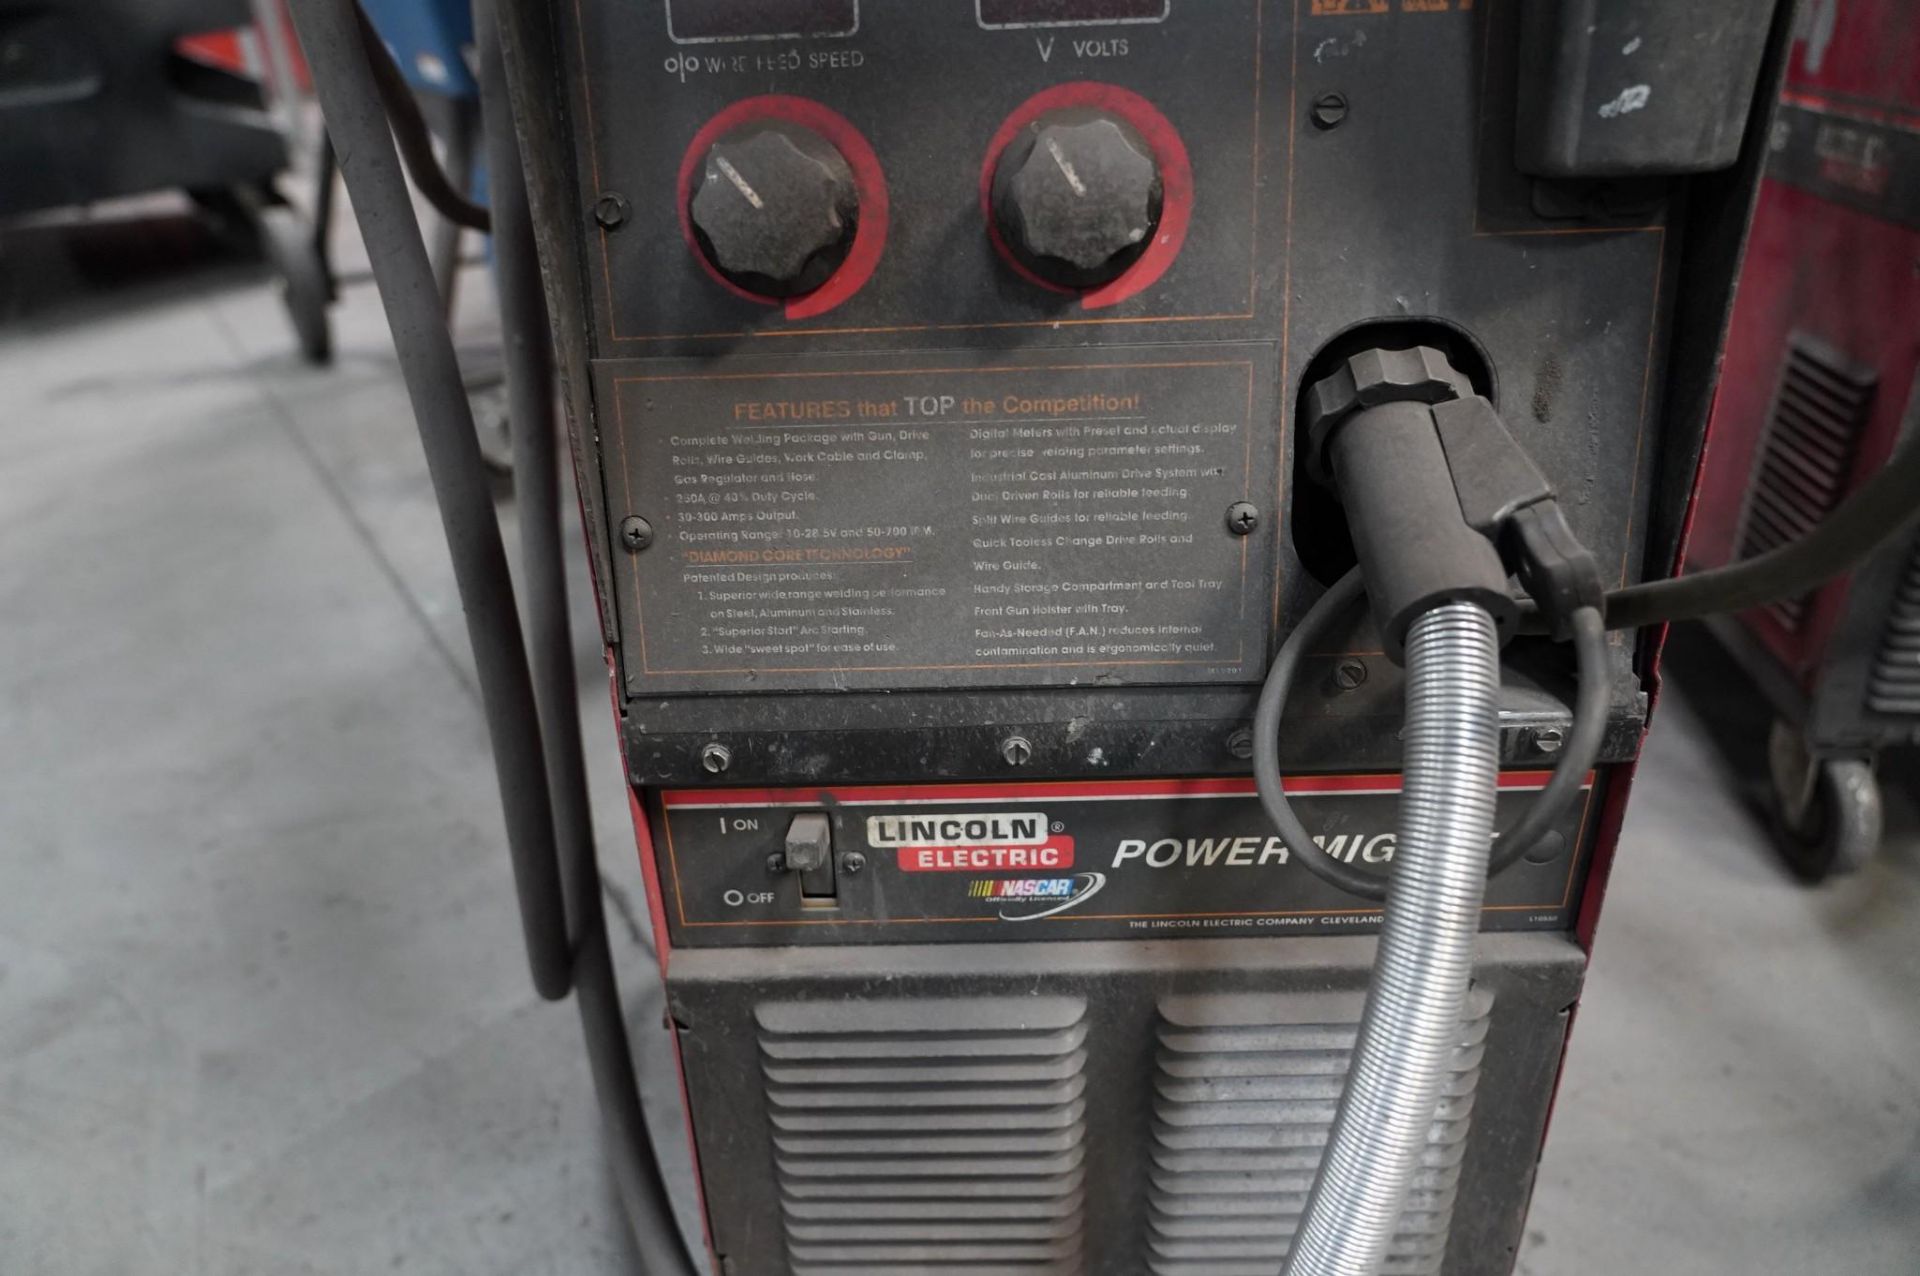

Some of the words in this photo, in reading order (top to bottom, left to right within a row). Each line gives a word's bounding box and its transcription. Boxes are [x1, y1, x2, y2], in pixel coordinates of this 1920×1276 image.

[1072, 38, 1129, 58] VOLTS
[808, 50, 864, 69] SPEED
[734, 400, 850, 420] FEATURES
[857, 400, 898, 417] that
[903, 395, 955, 416] TOP
[961, 398, 995, 414] the
[1003, 394, 1140, 414] Competition!
[670, 435, 729, 447] Complete
[731, 434, 781, 446] Welding
[783, 433, 838, 445] Package
[841, 432, 864, 442] with
[899, 430, 930, 440] Drive
[969, 427, 1009, 440] Digital
[1012, 426, 1053, 438] Meters
[1056, 426, 1081, 437] with
[1083, 424, 1121, 437] Preset
[1123, 424, 1148, 435] and
[706, 454, 733, 464] Wire
[784, 452, 814, 462] Work
[817, 451, 854, 461] Cable
[857, 450, 881, 461] and
[1088, 444, 1151, 457] parameter
[1154, 443, 1205, 456] settings.
[674, 474, 698, 485] Gas
[700, 473, 758, 486] Regulator
[760, 472, 784, 482] and
[1029, 470, 1057, 481] Cast
[1060, 469, 1118, 481] Aluminum
[1121, 468, 1153, 480] Drive
[1155, 466, 1198, 479] System
[751, 491, 778, 503] Duty
[1002, 490, 1039, 501] Driven
[1042, 489, 1071, 500] Rolls
[1074, 488, 1089, 499] for
[1092, 488, 1138, 499] reliable
[677, 512, 719, 522] 30-300
[721, 512, 753, 523] Amps
[1000, 513, 1027, 524] Wire
[1029, 513, 1072, 523] Guides
[1074, 512, 1089, 522] for
[1093, 510, 1138, 521] reliable
[679, 530, 739, 543] Operating
[840, 527, 865, 538] and
[866, 526, 908, 537] 50-700
[973, 537, 1007, 548] Quick
[1105, 534, 1136, 545] Drive
[1139, 534, 1167, 544] Rolls
[1169, 533, 1193, 543] and
[973, 560, 999, 571] Wire
[1002, 559, 1041, 571] Guide.
[683, 572, 735, 583] Patented
[737, 571, 777, 583] Design
[974, 583, 1010, 595] Handy
[1014, 583, 1060, 594] Storage
[1062, 580, 1142, 593] Compartment
[1145, 579, 1168, 590] and
[1171, 579, 1196, 589] Tool
[1198, 578, 1222, 590] Tray
[709, 589, 757, 602] Superior
[759, 589, 786, 600] wide
[788, 590, 822, 601] range
[824, 587, 870, 600] welding
[710, 610, 725, 618] on
[760, 607, 816, 618] Aluminum
[818, 606, 840, 617] and
[974, 606, 1003, 616] Front
[1006, 605, 1030, 616] Gun
[1032, 604, 1072, 615] Holster
[1075, 603, 1098, 614] with
[1101, 602, 1128, 614] Tray.
[800, 624, 819, 635] Arc
[1108, 624, 1155, 635] reduces
[714, 643, 743, 654] Wide
[817, 642, 831, 653] for
[833, 643, 861, 653] ease
[863, 641, 874, 652] of
[975, 644, 1058, 656] contamination
[1061, 644, 1084, 654] and
[1087, 643, 1095, 653] is
[1098, 641, 1183, 655] ergonomically
[733, 819, 759, 831] ON
[878, 818, 1037, 842] LINCOLN
[1111, 836, 1291, 868] POWER
[1314, 833, 1397, 864] MIG
[918, 848, 1059, 868] ELECTRIC
[1000, 878, 1071, 896] NASCAR
[747, 892, 775, 904] OFF
[1129, 919, 1149, 929] THE
[1151, 918, 1200, 928] LINCOLN
[1203, 917, 1254, 927] ELECTRIC
[1256, 916, 1315, 927] COMPANY
[1321, 915, 1385, 925] CLEVELAND
